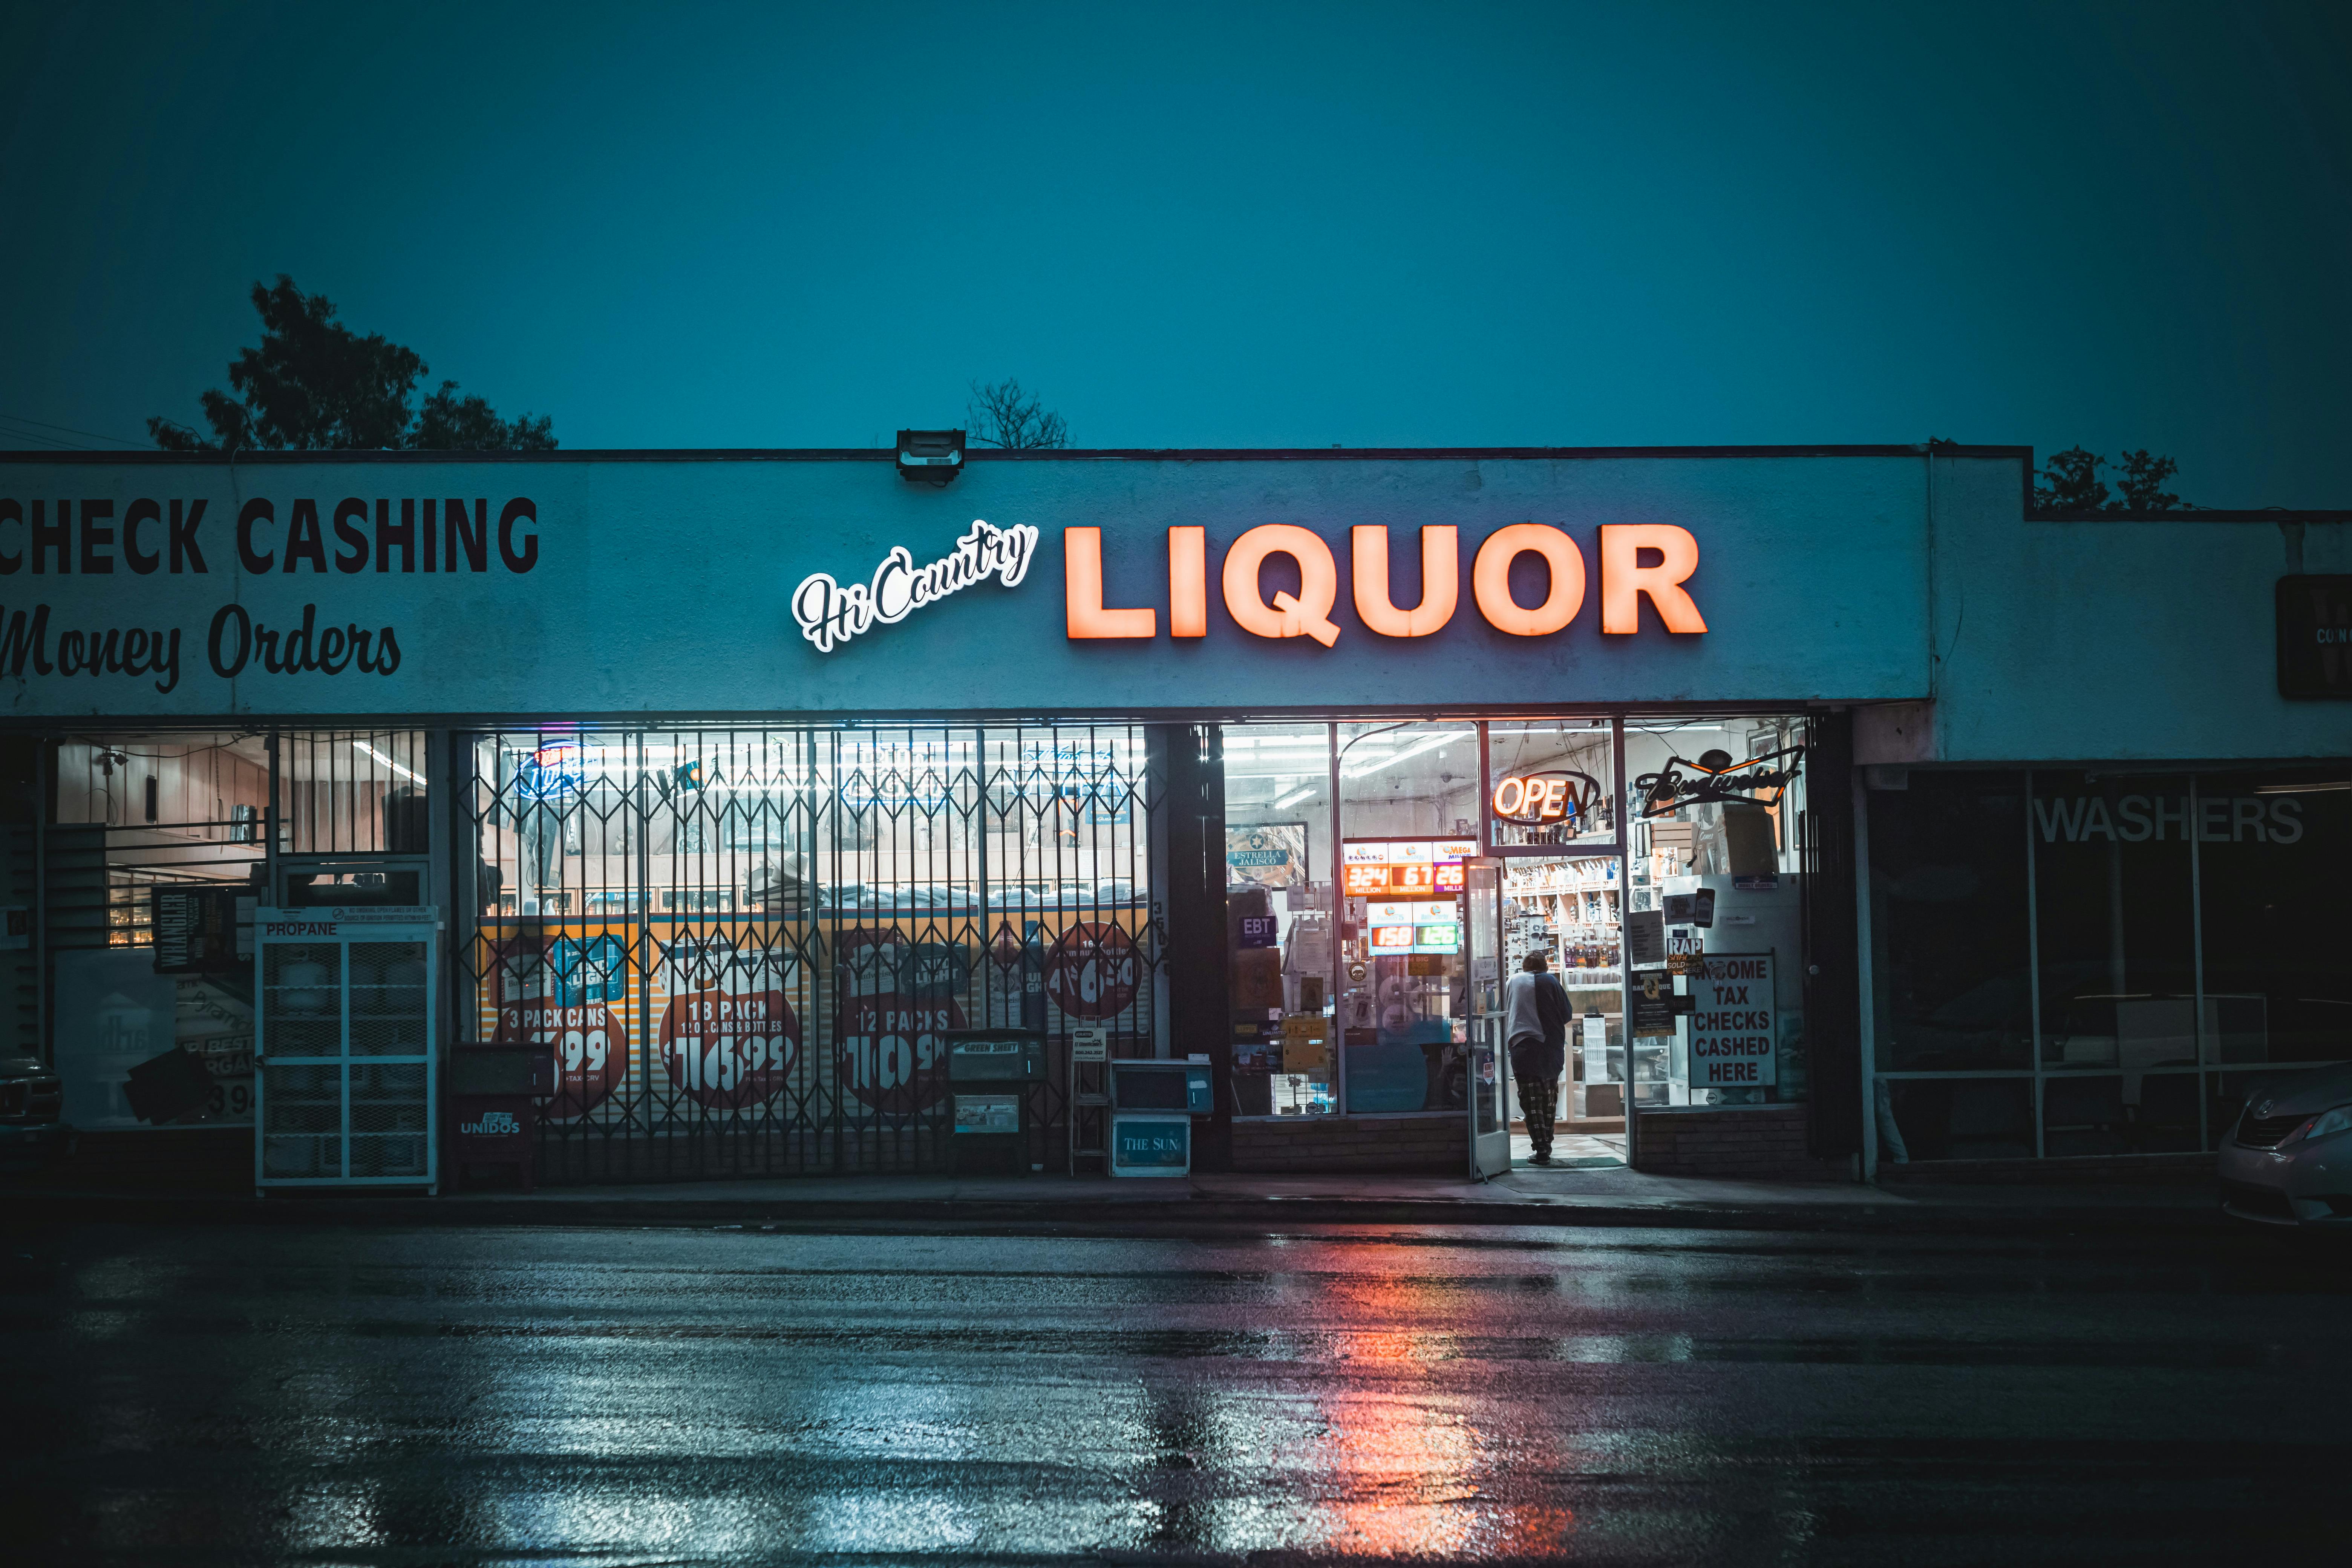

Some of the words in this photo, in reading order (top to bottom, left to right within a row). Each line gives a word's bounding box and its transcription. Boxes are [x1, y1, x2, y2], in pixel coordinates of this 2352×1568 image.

[0, 498, 208, 575] CHECK
[237, 497, 538, 574] CASHING
[870, 520, 1038, 625] Country
[1064, 522, 1709, 648] LIQUOR
[2317, 627, 2346, 643] CON
[0, 604, 181, 694] Money
[208, 604, 401, 678] Orders
[1011, 769, 1125, 796] ULTRA
[1493, 776, 1589, 817] OPEN
[2034, 794, 2303, 844] WASHERS
[1449, 846, 1471, 854] MEGA
[1348, 868, 1388, 887] 324
[1405, 867, 1432, 885] 67
[160, 893, 187, 968] WRANGLER
[266, 922, 337, 936] PROPANE
[1244, 918, 1270, 934] EBT
[1424, 926, 1456, 945] 126
[1378, 927, 1412, 946] 158
[1669, 939, 1702, 955] RAP
[573, 970, 612, 985] LIGHT
[1713, 986, 1749, 1006] TAX
[510, 1010, 518, 1028] 3
[524, 1008, 562, 1028] PACK
[567, 1008, 605, 1027] CANS
[689, 1001, 712, 1021] 18
[723, 1000, 767, 1020] PACK
[737, 1021, 742, 1032] &
[1694, 1011, 1769, 1031] CHECKS
[965, 1044, 990, 1052] GREEN
[992, 1042, 1017, 1052] SHEET
[1696, 1037, 1769, 1057] CASHED
[1709, 1063, 1758, 1082] HERE
[461, 1122, 519, 1134] UNIDOS
[1124, 1138, 1148, 1150] THE
[1153, 1138, 1178, 1150] SUN
